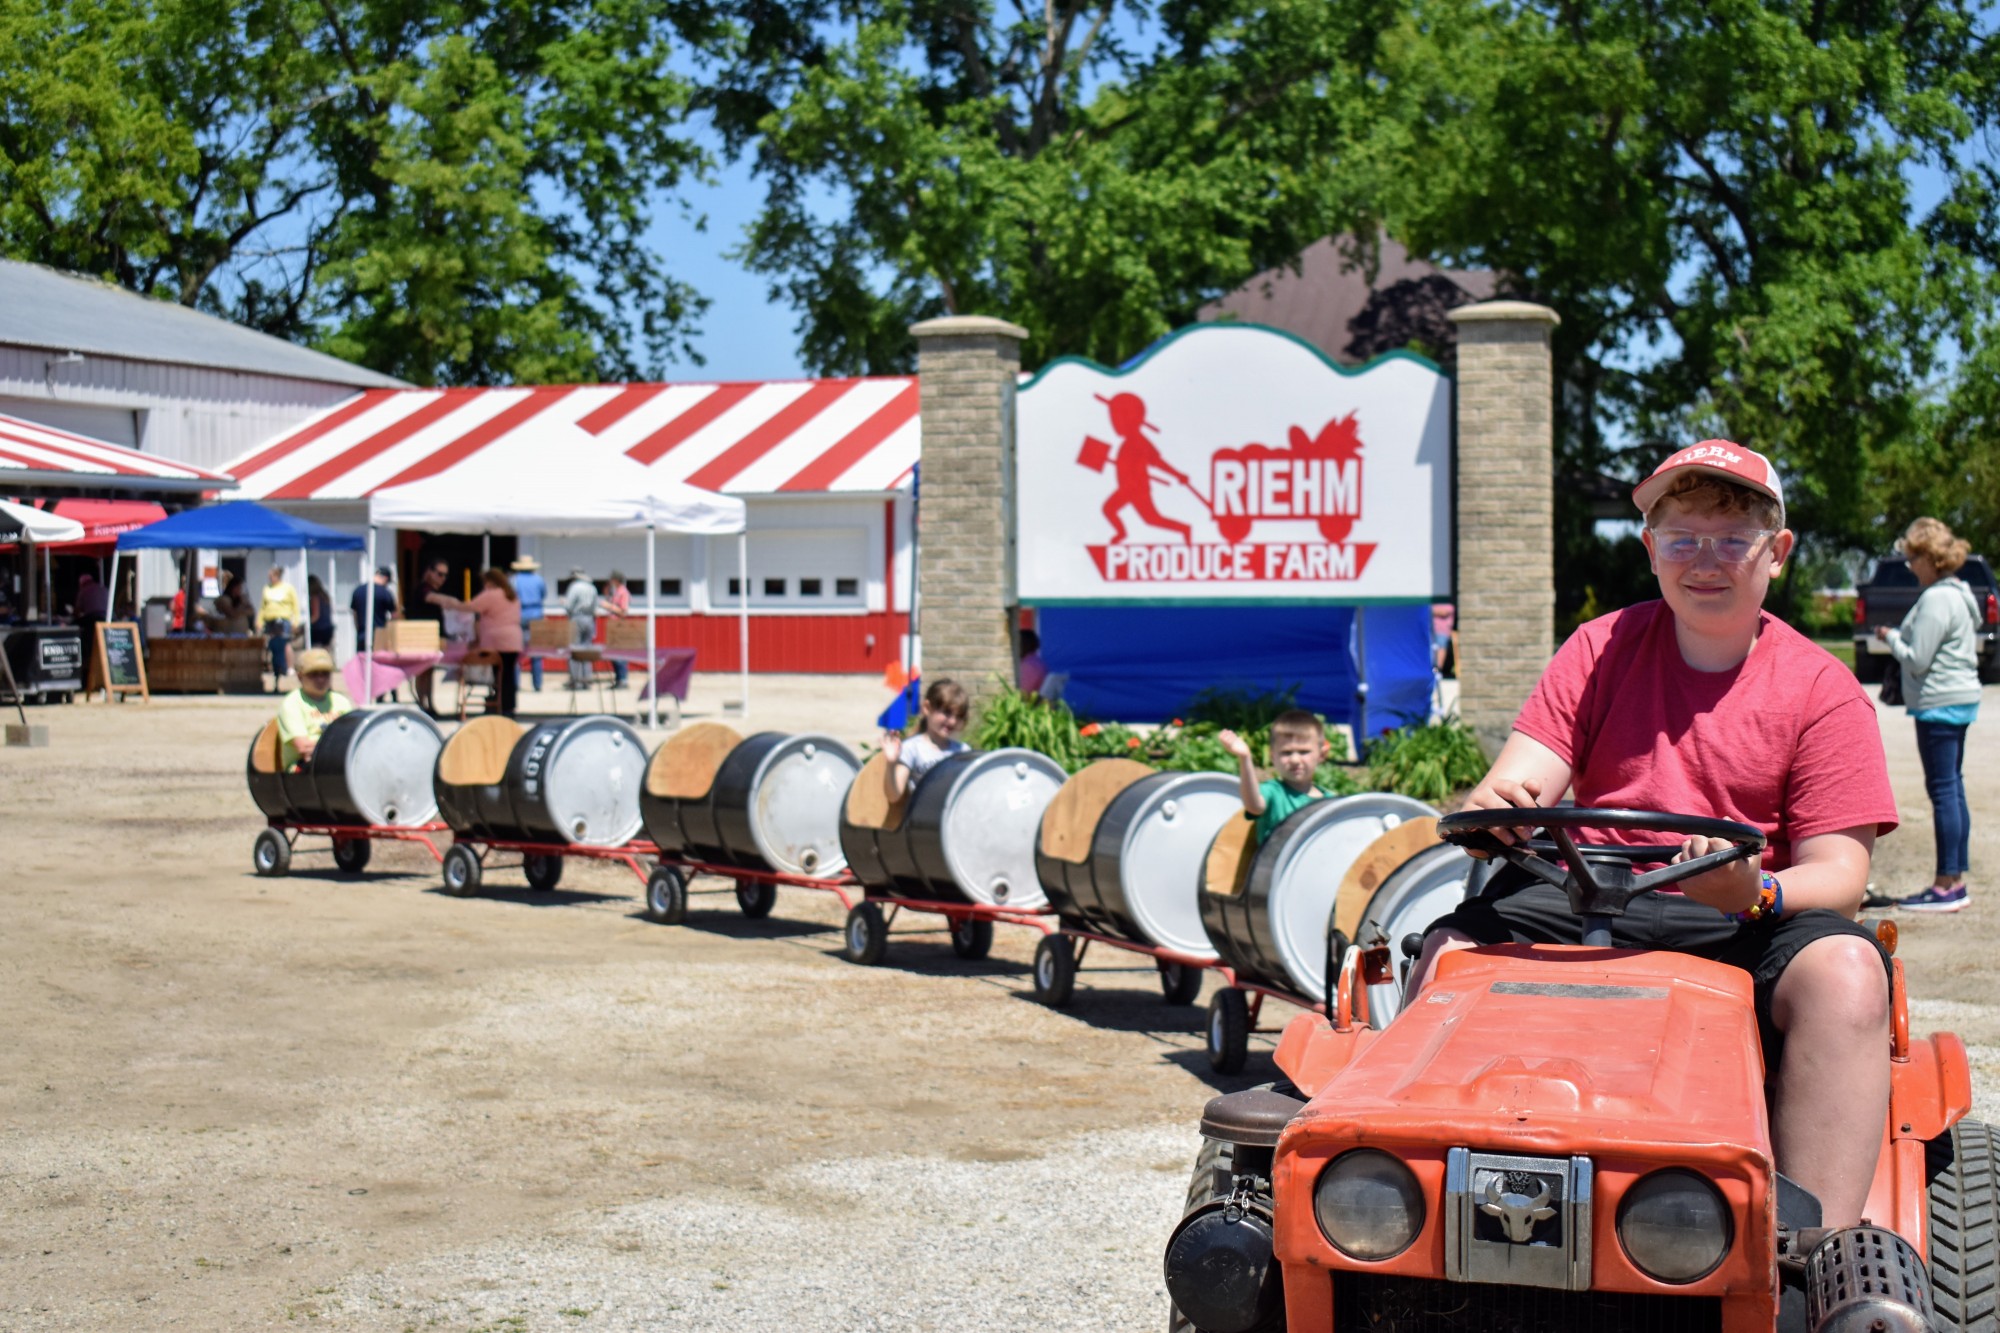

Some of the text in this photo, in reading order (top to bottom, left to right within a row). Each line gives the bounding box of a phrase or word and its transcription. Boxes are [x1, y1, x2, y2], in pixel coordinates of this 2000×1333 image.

[1213, 459, 1360, 516] RIEHM
[1106, 545, 1356, 580] PRODUCE FARM
